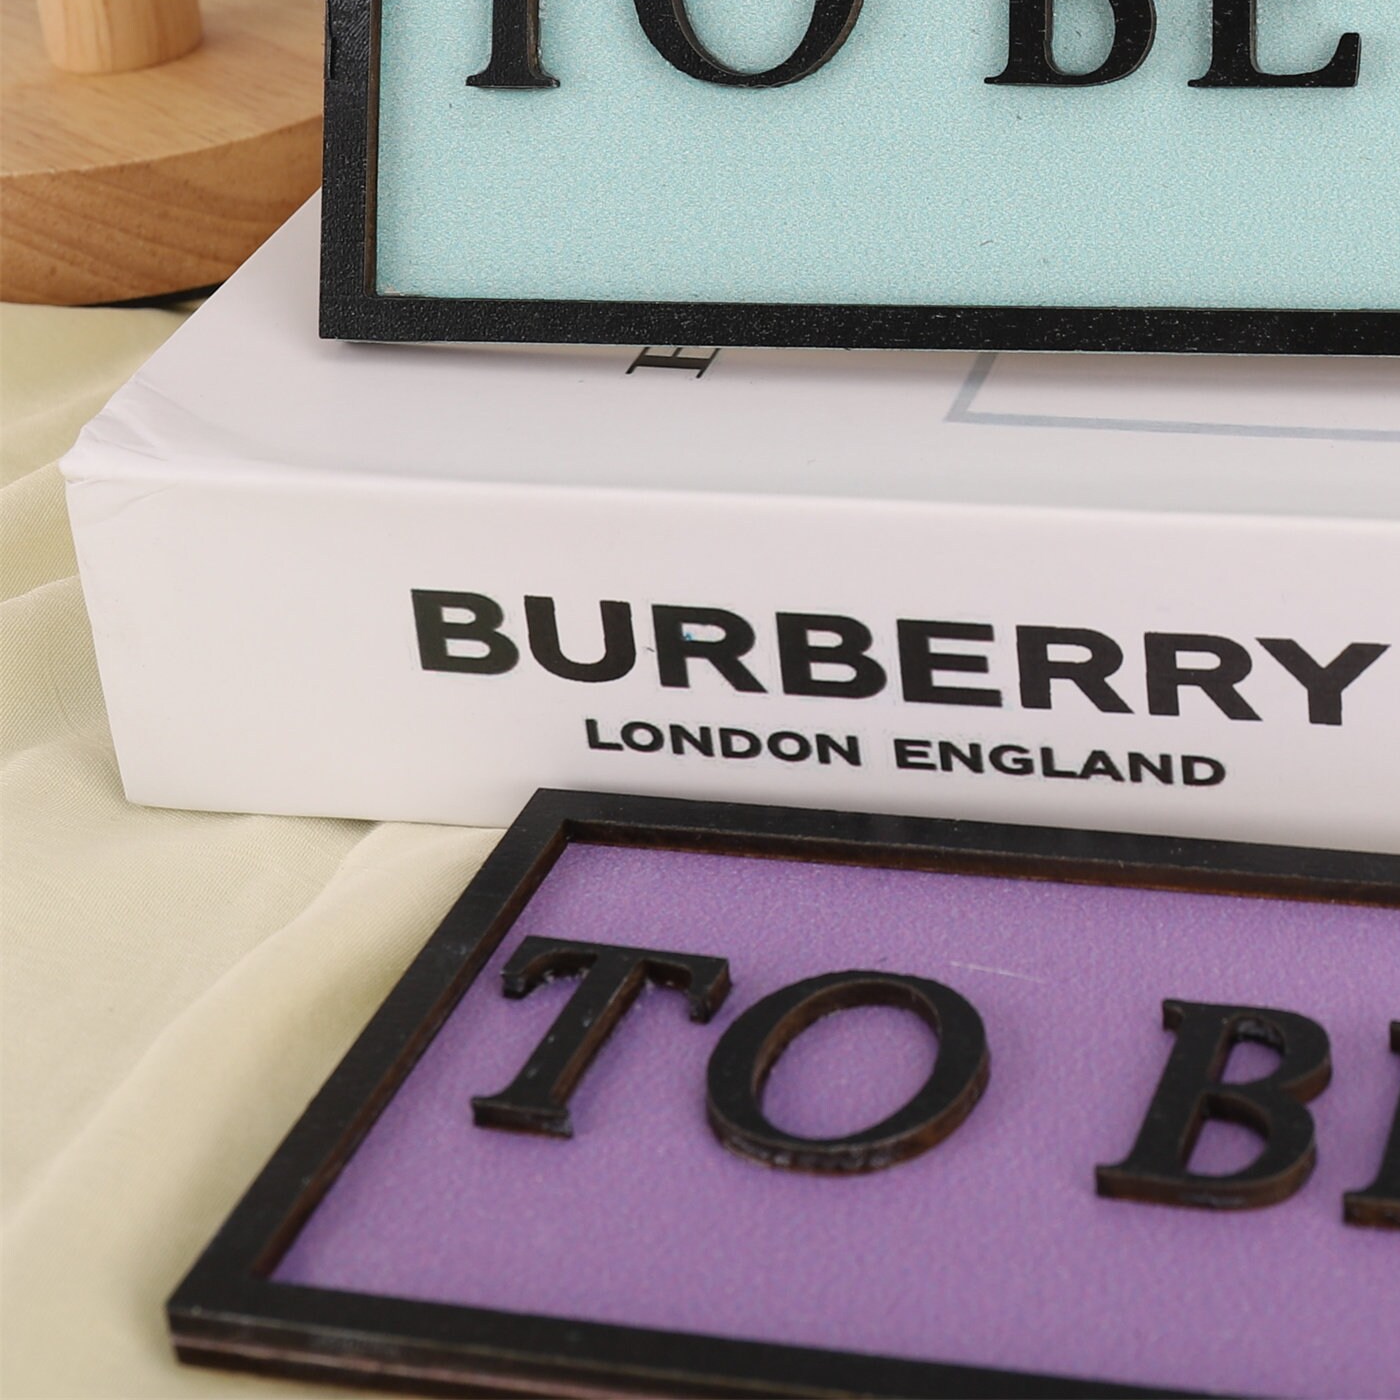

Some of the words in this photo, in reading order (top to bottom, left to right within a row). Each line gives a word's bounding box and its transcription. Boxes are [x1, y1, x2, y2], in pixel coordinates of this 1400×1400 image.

[411, 589, 1390, 727] BURBERRY
[585, 718, 862, 767] LONDON
[893, 738, 1226, 787] ENGLAND
[470, 934, 990, 1177] TO
